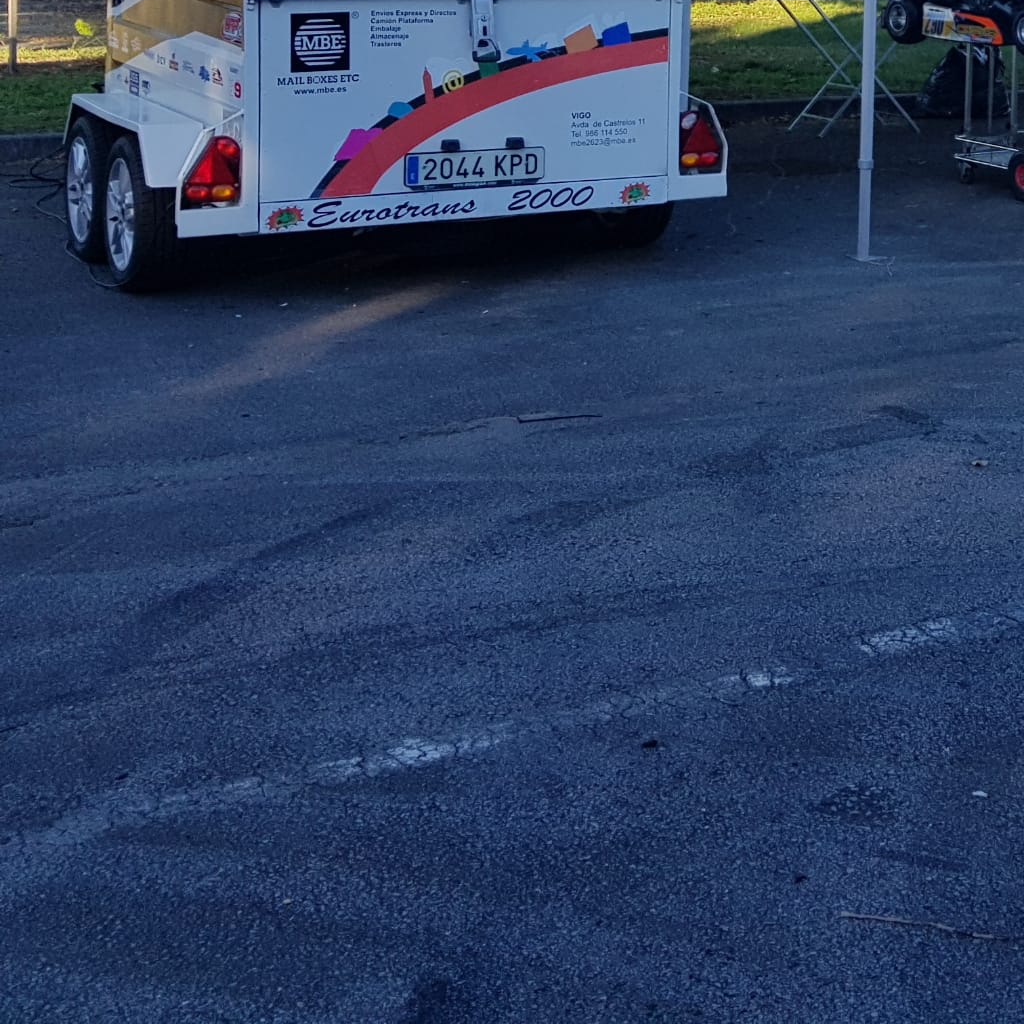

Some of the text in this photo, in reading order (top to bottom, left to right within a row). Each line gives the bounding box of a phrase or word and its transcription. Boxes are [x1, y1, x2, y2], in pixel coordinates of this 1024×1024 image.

[370, 33, 410, 41] Almacenaje
[301, 35, 342, 51] MBE
[277, 74, 360, 86] MAIL BOXES ETC
[293, 86, 347, 95] www.mbe.es
[571, 111, 592, 119] VIGO
[614, 128, 628, 136] 550
[423, 155, 485, 181] 2044
[494, 153, 538, 177] KPD
[307, 186, 594, 227] Eurotrans 2000
